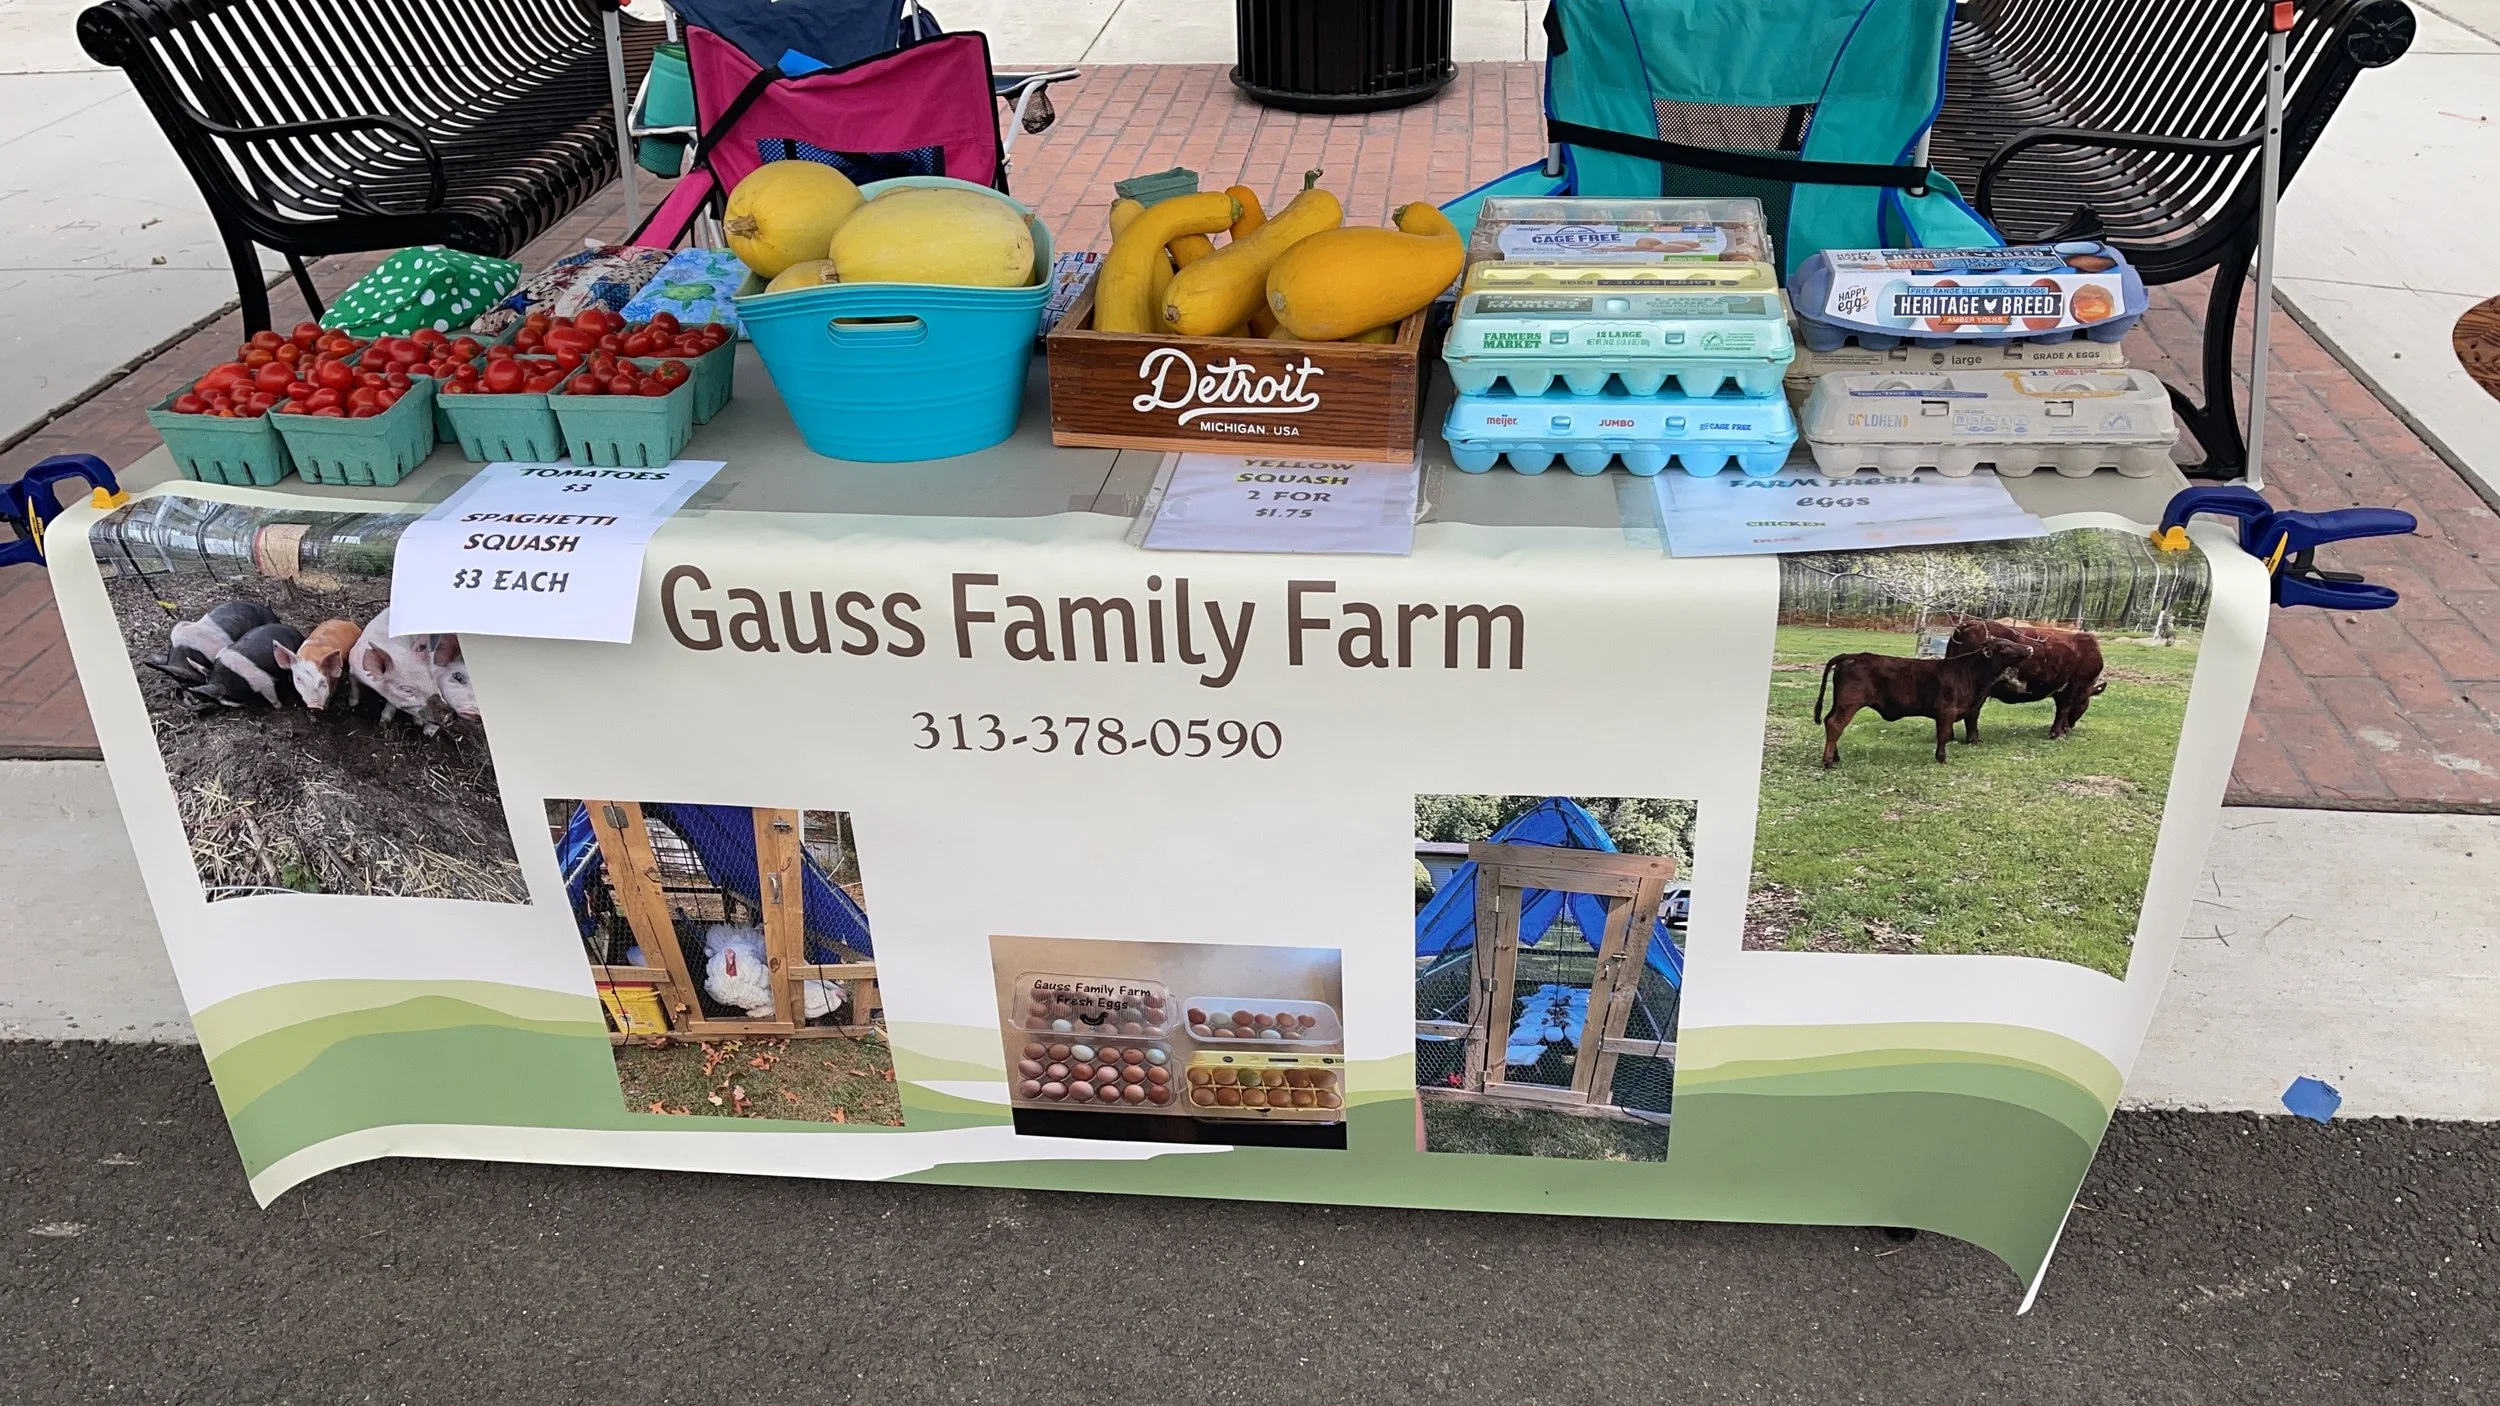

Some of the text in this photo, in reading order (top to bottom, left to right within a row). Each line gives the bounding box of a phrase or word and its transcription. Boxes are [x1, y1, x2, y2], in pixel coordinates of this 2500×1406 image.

[1532, 233, 1621, 243] CAGE FREE
[1838, 286, 1868, 301] HAPPY
[1838, 297, 1869, 315] egg
[1901, 296, 2054, 315] HERITAGE BREED
[1484, 332, 1541, 340] FARMERS
[1483, 340, 1541, 349] MARKET
[1951, 354, 1983, 366] large
[2033, 352, 2065, 360] GRADE
[2076, 351, 2101, 359] EGGS
[1132, 347, 1325, 425] Detroit
[1599, 419, 1635, 427] JUMBO
[1273, 426, 1300, 437] USA
[1244, 459, 1356, 471] YELLOW
[519, 468, 671, 480] TOMATOES
[1236, 473, 1350, 485] SQUASH
[562, 483, 593, 493] $3
[1729, 478, 1821, 488] FARM
[1247, 490, 1332, 502] 2 FOR
[1255, 508, 1313, 518] $1.75
[460, 513, 619, 526] SPAGHETTI
[463, 533, 581, 552] SQUASH
[452, 568, 570, 593] $3 EACH
[660, 564, 1525, 689] Gauss Family Farm
[912, 711, 1282, 760] 313-378-0590
[1034, 979, 1151, 997] Gauss Family Farm
[1056, 994, 1128, 1010] Fresh Eggs
